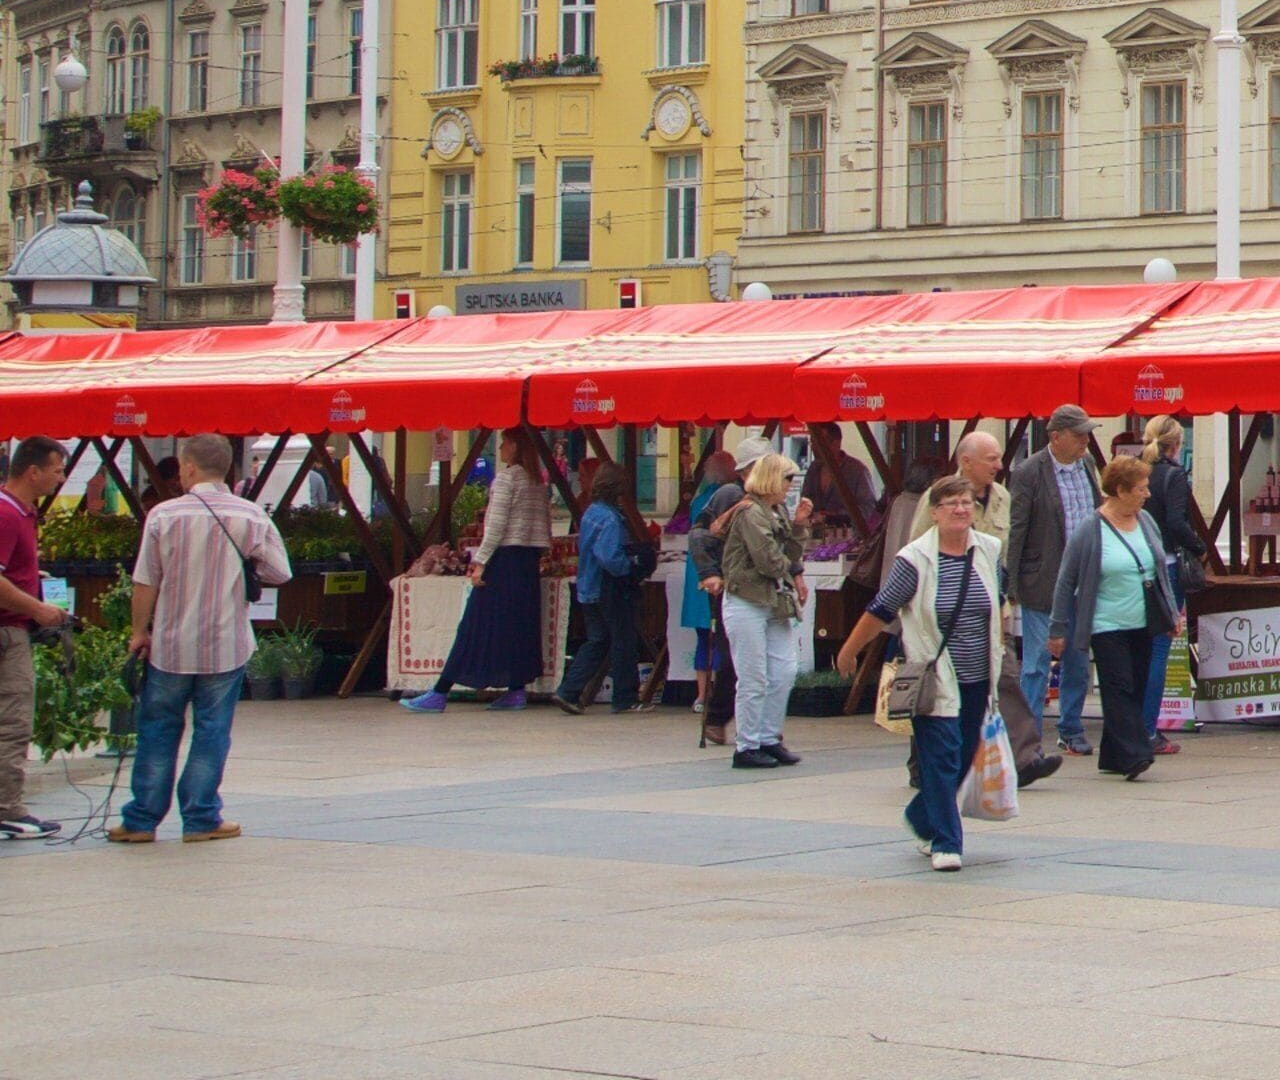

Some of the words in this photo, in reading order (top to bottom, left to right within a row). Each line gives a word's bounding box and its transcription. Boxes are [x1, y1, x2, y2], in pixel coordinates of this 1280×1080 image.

[465, 294, 517, 309] SPLITSKA
[520, 292, 564, 307] BANKA
[1205, 676, 1264, 698] Organska
